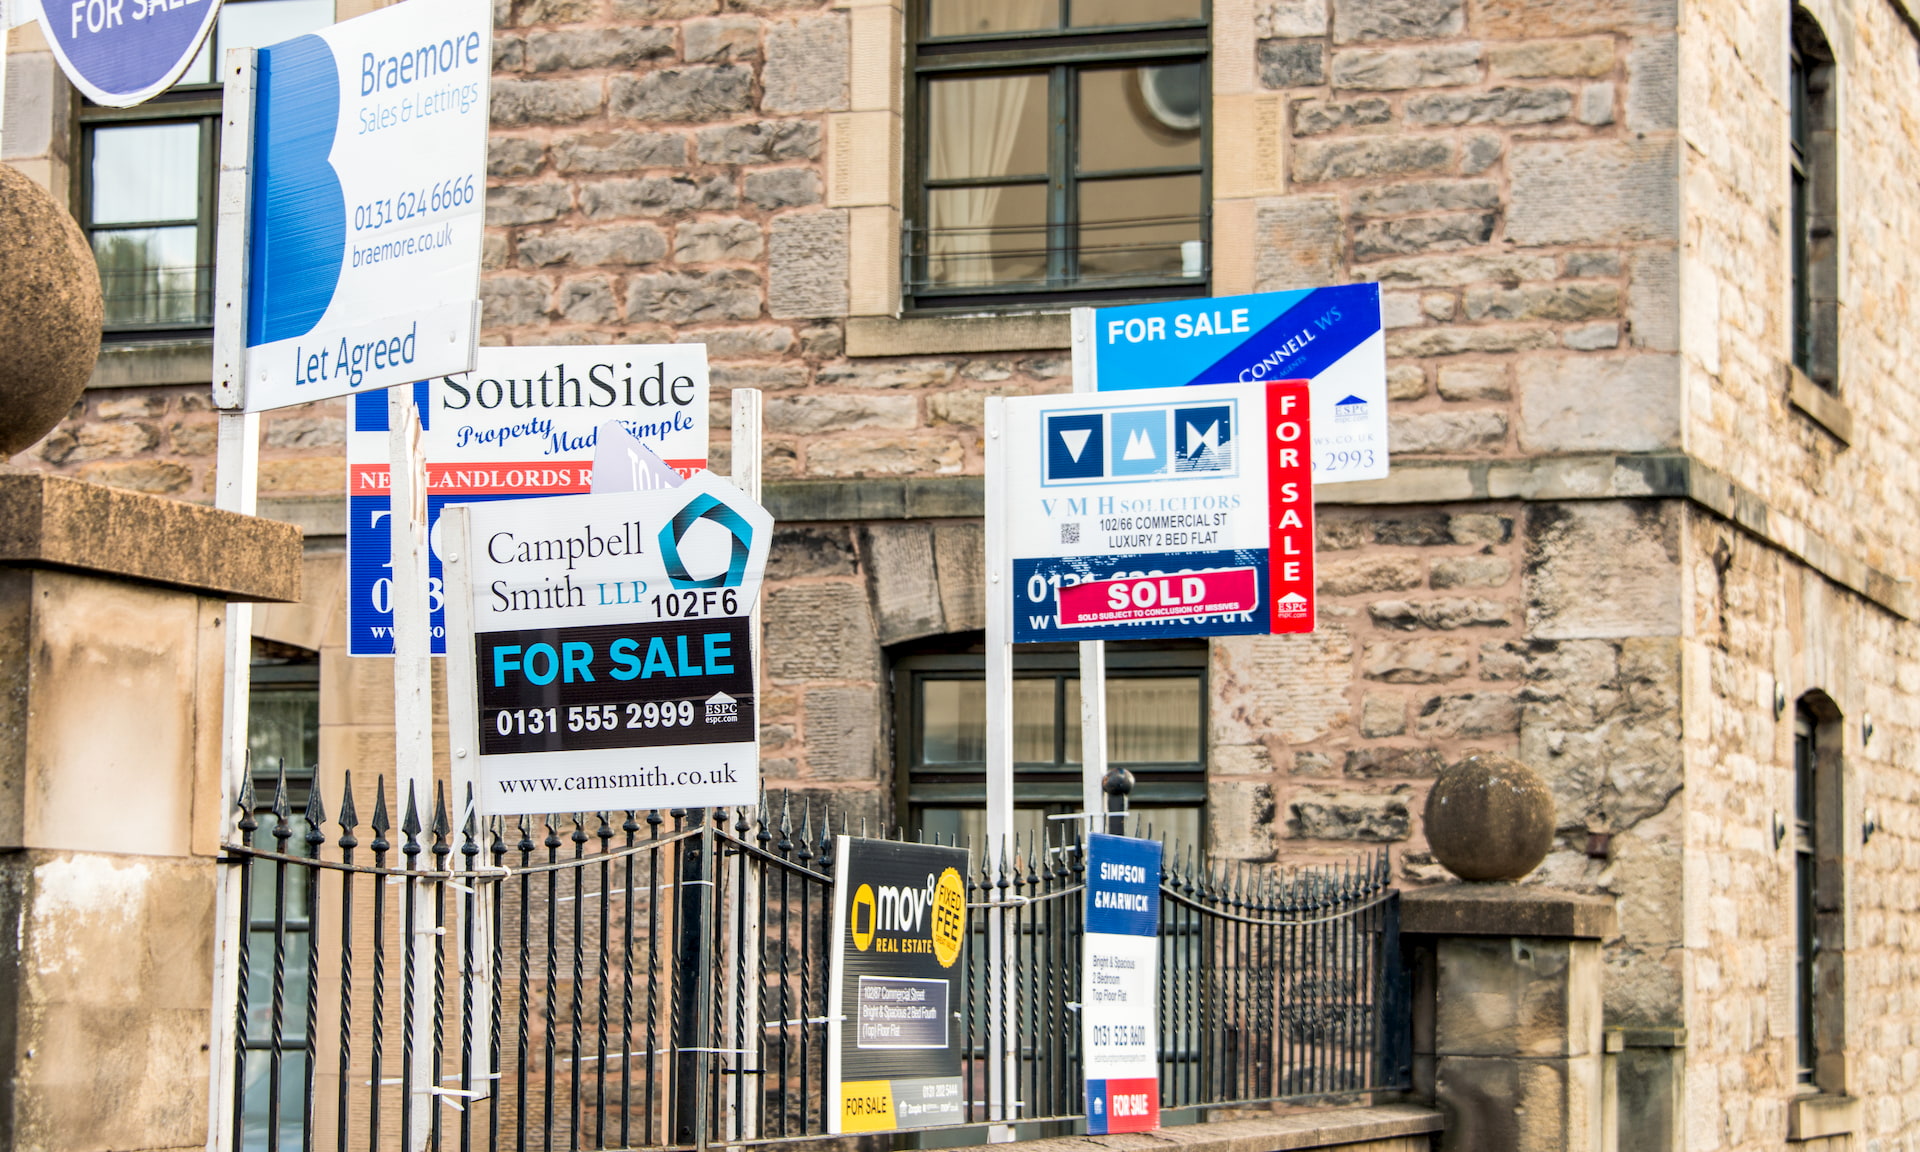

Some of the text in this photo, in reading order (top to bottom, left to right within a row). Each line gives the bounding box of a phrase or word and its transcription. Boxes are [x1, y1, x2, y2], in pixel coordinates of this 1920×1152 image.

[72, 0, 124, 39] FOR
[361, 31, 480, 97] Braemore
[358, 82, 479, 135] Sales & Lettings
[355, 174, 474, 231] 0131 624 6666
[352, 222, 453, 268] braemore.co.uk
[1108, 308, 1250, 345] FOR SALE
[296, 321, 417, 388] Let Agreed
[1238, 306, 1342, 383] CONNELL WS
[443, 361, 696, 411] SouthSide
[456, 417, 555, 448] Property
[544, 426, 598, 455] Mad
[1325, 449, 1375, 472] 2993
[360, 471, 391, 489] NE
[424, 468, 572, 489] LANDLORDS
[1276, 395, 1303, 582] FOR SALE
[1120, 493, 1241, 514] SOLICITORS
[1099, 512, 1228, 532] 102/66 COMMERCIAL ST
[488, 521, 645, 571] Campbell
[1108, 530, 1218, 549] LUXURY 2 BED FLAT
[491, 575, 649, 613] Smith LLP
[651, 588, 739, 619] 102F6
[1107, 577, 1206, 610] SOLD
[1279, 602, 1307, 611] ESPC
[1077, 613, 1098, 622] SOLD
[1099, 611, 1133, 621] SUBJECT
[1134, 609, 1144, 617] TO
[1144, 606, 1193, 617] CONCLUSION
[1194, 605, 1204, 613] OF
[1205, 601, 1240, 612] MISSIVES
[493, 632, 735, 688] FOR SALE
[496, 700, 695, 736] 0131 555 2999
[705, 703, 738, 715] ESPC
[705, 715, 738, 725] espc.com
[499, 762, 738, 794] www.camsmith.co.uk
[1100, 862, 1147, 884] SIMPSON
[939, 884, 961, 911] FIXED
[936, 905, 960, 942] FEE
[876, 938, 933, 954] REAL ESTATE
[1092, 955, 1108, 970] Bright
[1097, 972, 1120, 984] Bedroom
[881, 986, 911, 1002] Commercial
[1092, 988, 1127, 1003] Top Floor Flat
[912, 1006, 922, 1018] Bed
[1093, 1025, 1146, 1046] 0131 525 8600
[846, 1098, 864, 1116] FOR
[866, 1096, 887, 1115] SALE
[1113, 1094, 1130, 1117] FOR
[1131, 1093, 1149, 1116] SALE
